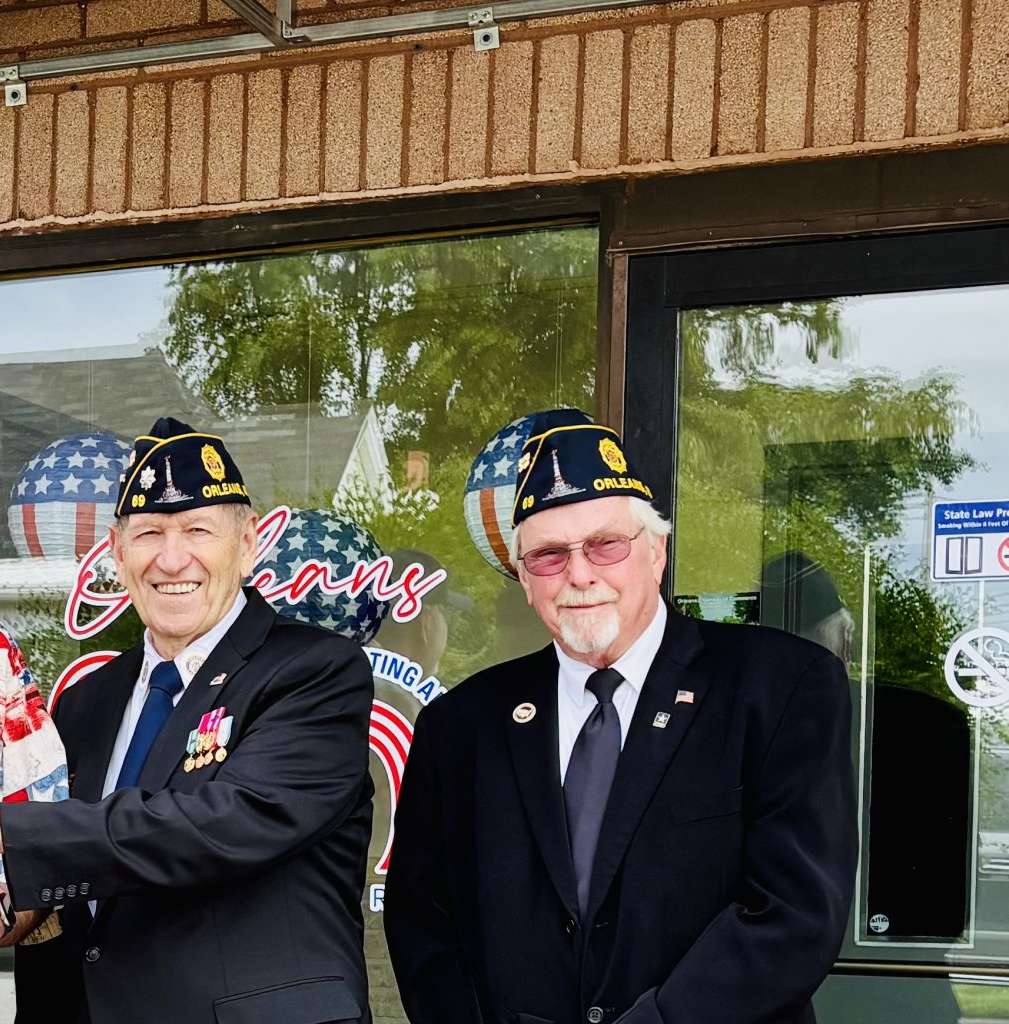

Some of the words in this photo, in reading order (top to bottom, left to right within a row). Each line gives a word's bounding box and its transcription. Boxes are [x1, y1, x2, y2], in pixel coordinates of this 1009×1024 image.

[131, 494, 146, 508] 69
[522, 495, 535, 510] 69
[944, 510, 970, 520] State
[973, 509, 993, 519] Law
[64, 504, 447, 640] Oleans
[370, 652, 418, 687] TING
[417, 681, 444, 702] A
